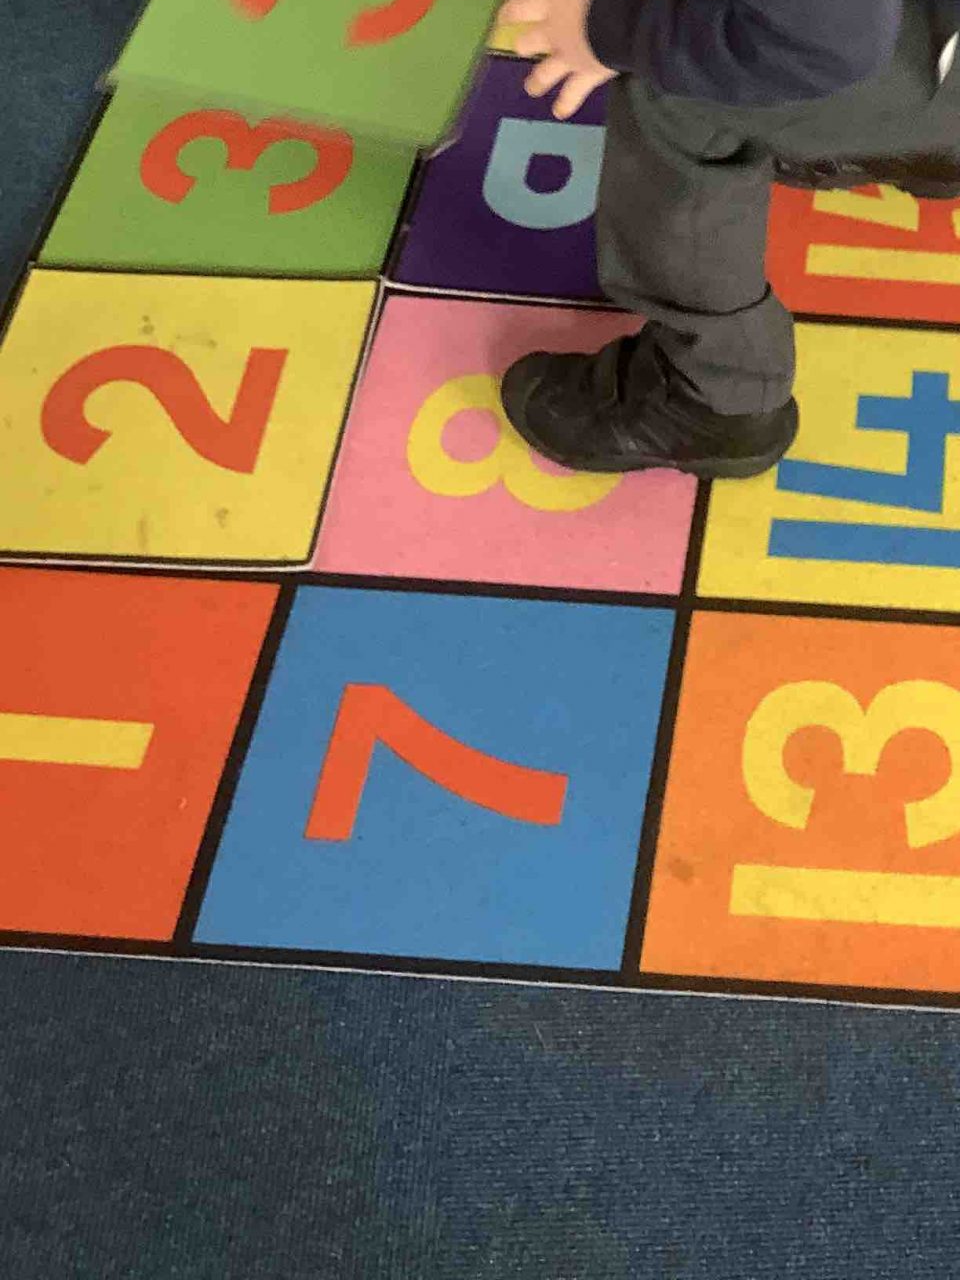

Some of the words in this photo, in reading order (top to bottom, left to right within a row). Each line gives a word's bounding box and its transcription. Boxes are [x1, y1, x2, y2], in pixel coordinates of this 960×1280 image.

[140, 108, 354, 215] 3
[40, 343, 289, 475] 2
[407, 373, 622, 512] 8
[304, 683, 569, 841] 7
